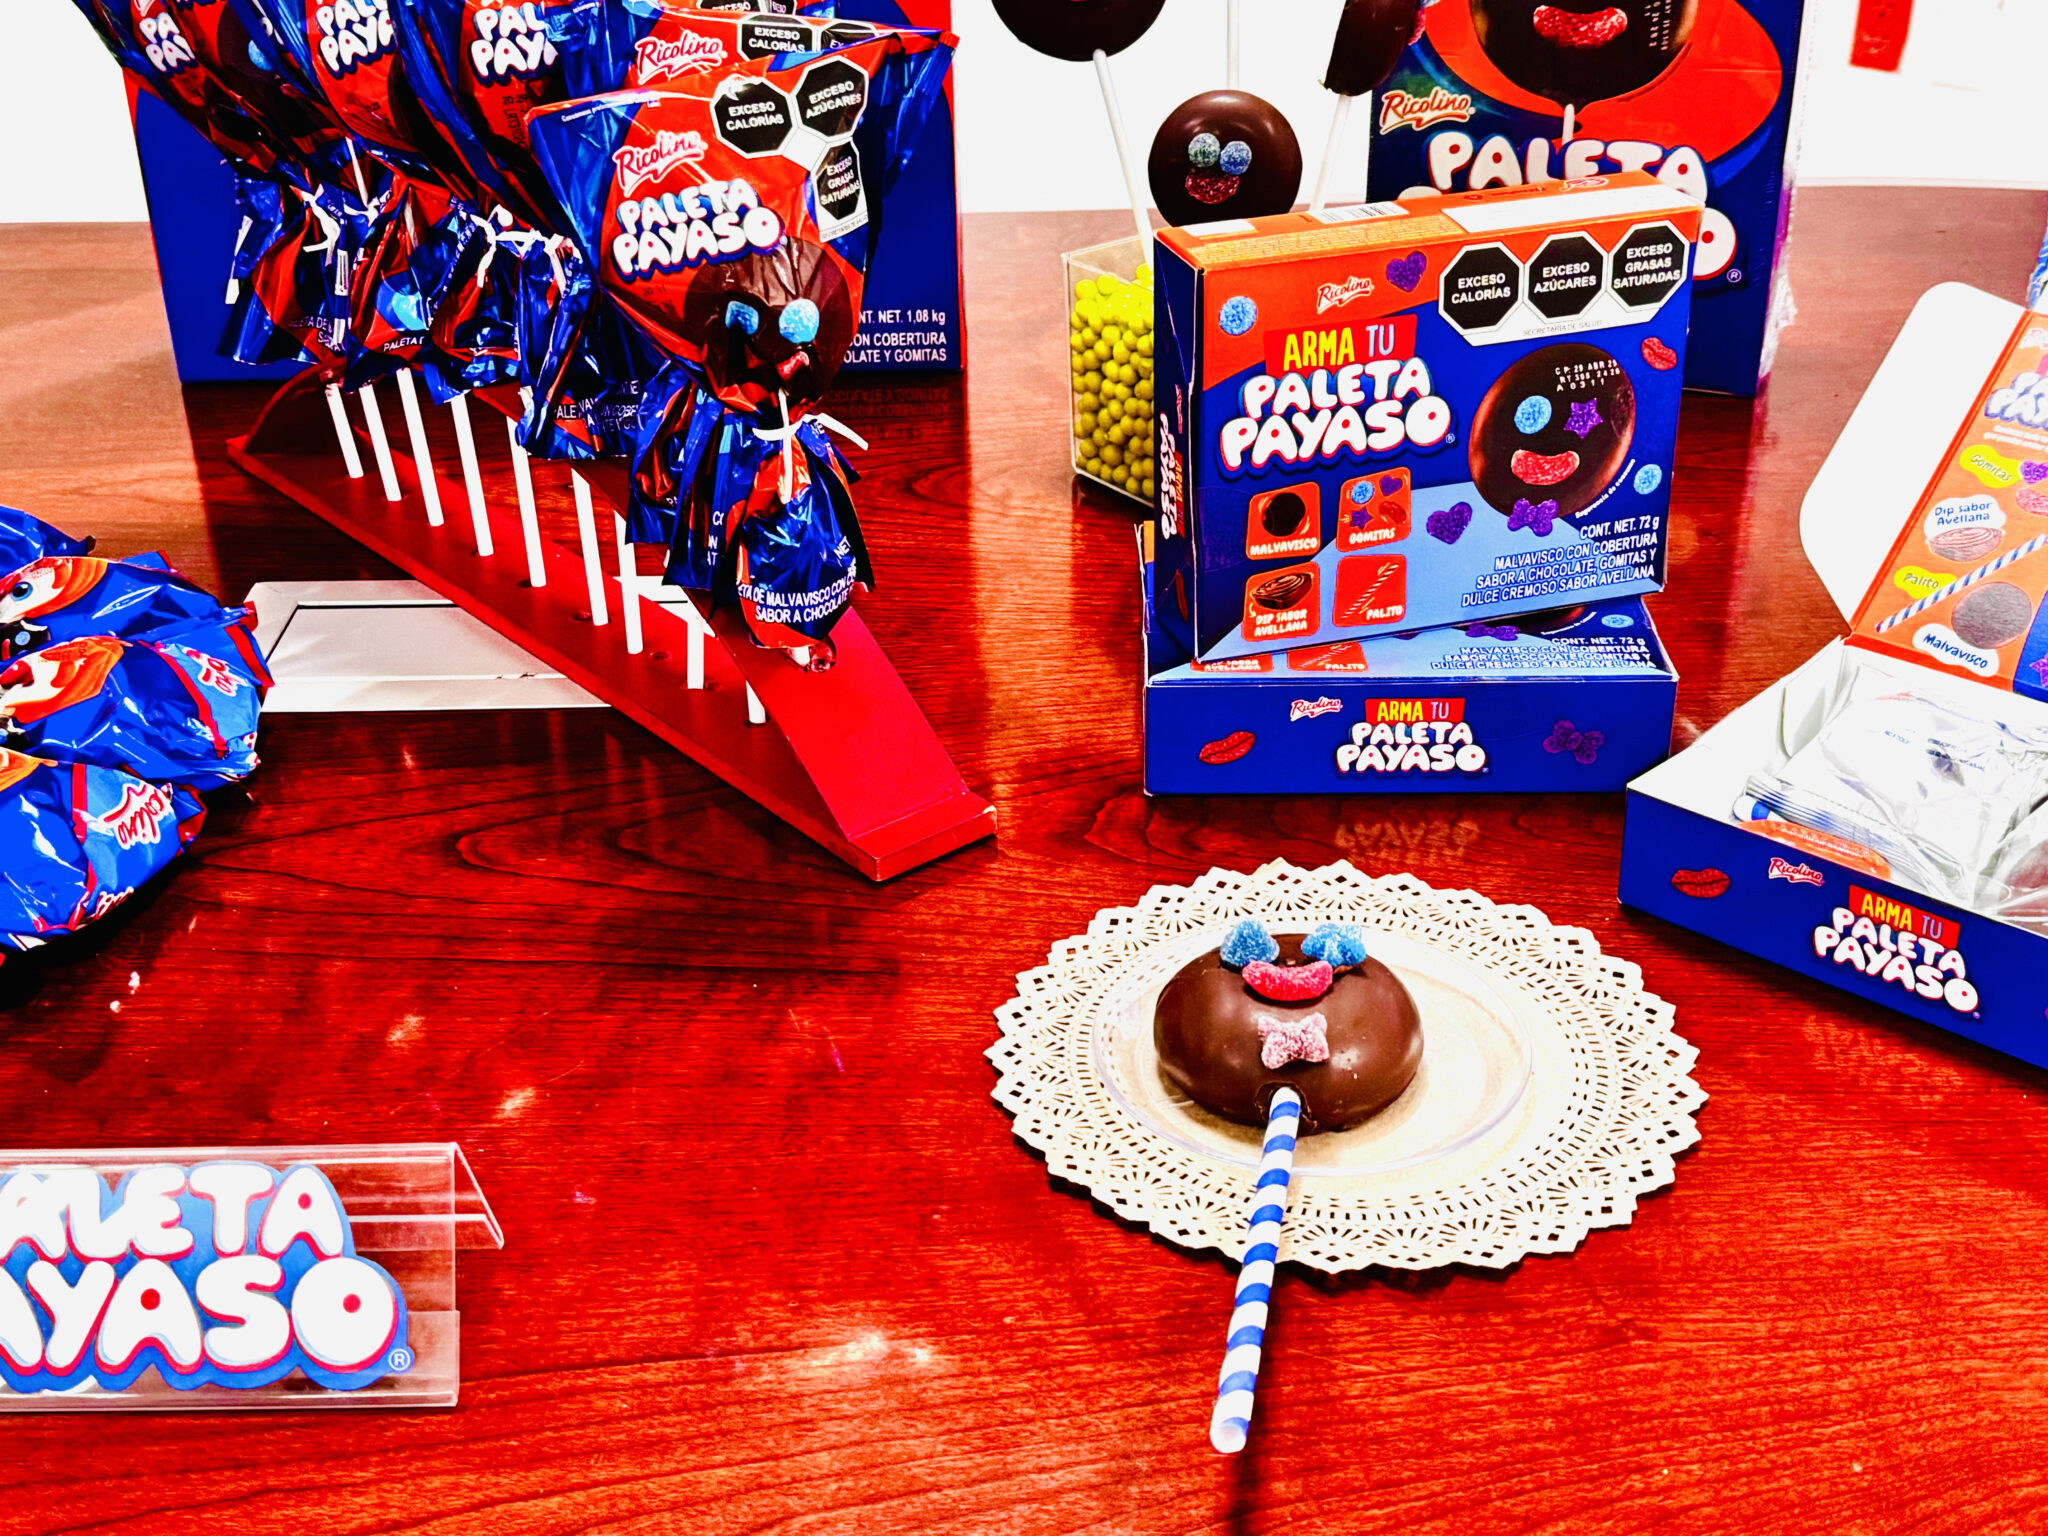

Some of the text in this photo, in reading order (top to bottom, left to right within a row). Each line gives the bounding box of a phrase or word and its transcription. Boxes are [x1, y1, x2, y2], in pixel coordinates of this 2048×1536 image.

[754, 27, 801, 40] EXCESO
[636, 30, 725, 84] Ricolino
[808, 81, 855, 104] EXCESO
[728, 101, 776, 117] EXCESO
[805, 94, 862, 118] AZÚCARES
[1379, 88, 1476, 134] Ricolino
[725, 113, 784, 131] CALORÍAS
[1429, 131, 1708, 204] PALETA
[617, 180, 759, 233] PALETA
[613, 207, 781, 275] PAYASO
[1625, 242, 1674, 260] EXCESO
[1541, 262, 1591, 279] EXCESO
[1624, 257, 1673, 274] GRASAS
[1457, 273, 1506, 290] EXCESO
[1533, 275, 1598, 294] AZÚCARES
[1612, 269, 1682, 290] SATURADAS
[1316, 275, 1375, 315] Ricolino
[1451, 286, 1512, 305] CALORÍAS
[858, 309, 946, 326] NT. NET. 1,08 kg
[873, 331, 947, 347] COBERTURA
[1282, 323, 1395, 370] ARMA TU
[883, 349, 892, 363] Y
[894, 348, 947, 363] GOMITAS
[1242, 356, 1432, 421] PALETA
[1220, 395, 1452, 471] PAYASO
[1970, 453, 2013, 482] Gomitas
[1934, 502, 1993, 517] Dip sabor
[1936, 513, 1991, 527] Avellana
[1348, 526, 1396, 545] GOMITAS
[1579, 515, 1660, 540] CONT. NET. 72 g
[1249, 538, 1318, 556] MALVAVISCO
[1493, 531, 1658, 572] MALVAVISCO CON COBERTURA
[1476, 547, 1658, 589] SABOR A CHOCOLATE, GOMITAS Y
[1461, 564, 1656, 608] DULCE CREMOSO SABOR AVELLANA
[1903, 572, 1940, 591] Palito
[752, 585, 765, 604] DE
[766, 586, 831, 608] MALVAVISCO
[755, 587, 849, 624] SABOR A CHOCOLATE
[1254, 620, 1308, 637] AVELLANA
[1255, 608, 1308, 626] DIP SABOR
[1461, 647, 1537, 655] MALVAVISCO
[1571, 645, 1650, 654] COBERTURA
[1551, 637, 1589, 646] CONT.
[1592, 637, 1617, 645] NET.
[1619, 636, 1635, 645] 72
[1922, 632, 1989, 671] Malvavisco
[1430, 661, 1474, 670] DULCE
[1476, 661, 1540, 669] CREMOSO
[1290, 696, 1342, 721] Ricolino
[1376, 701, 1451, 722] ARMA TU
[1351, 721, 1473, 747] PALETA
[1336, 743, 1489, 774] PAYASO
[1768, 856, 1825, 887] Ricolino
[1860, 892, 1943, 939] ARMA TU
[1831, 907, 1967, 978] PALETA
[1812, 924, 1980, 1013] PAYASO
[0, 1163, 346, 1259] ALETA
